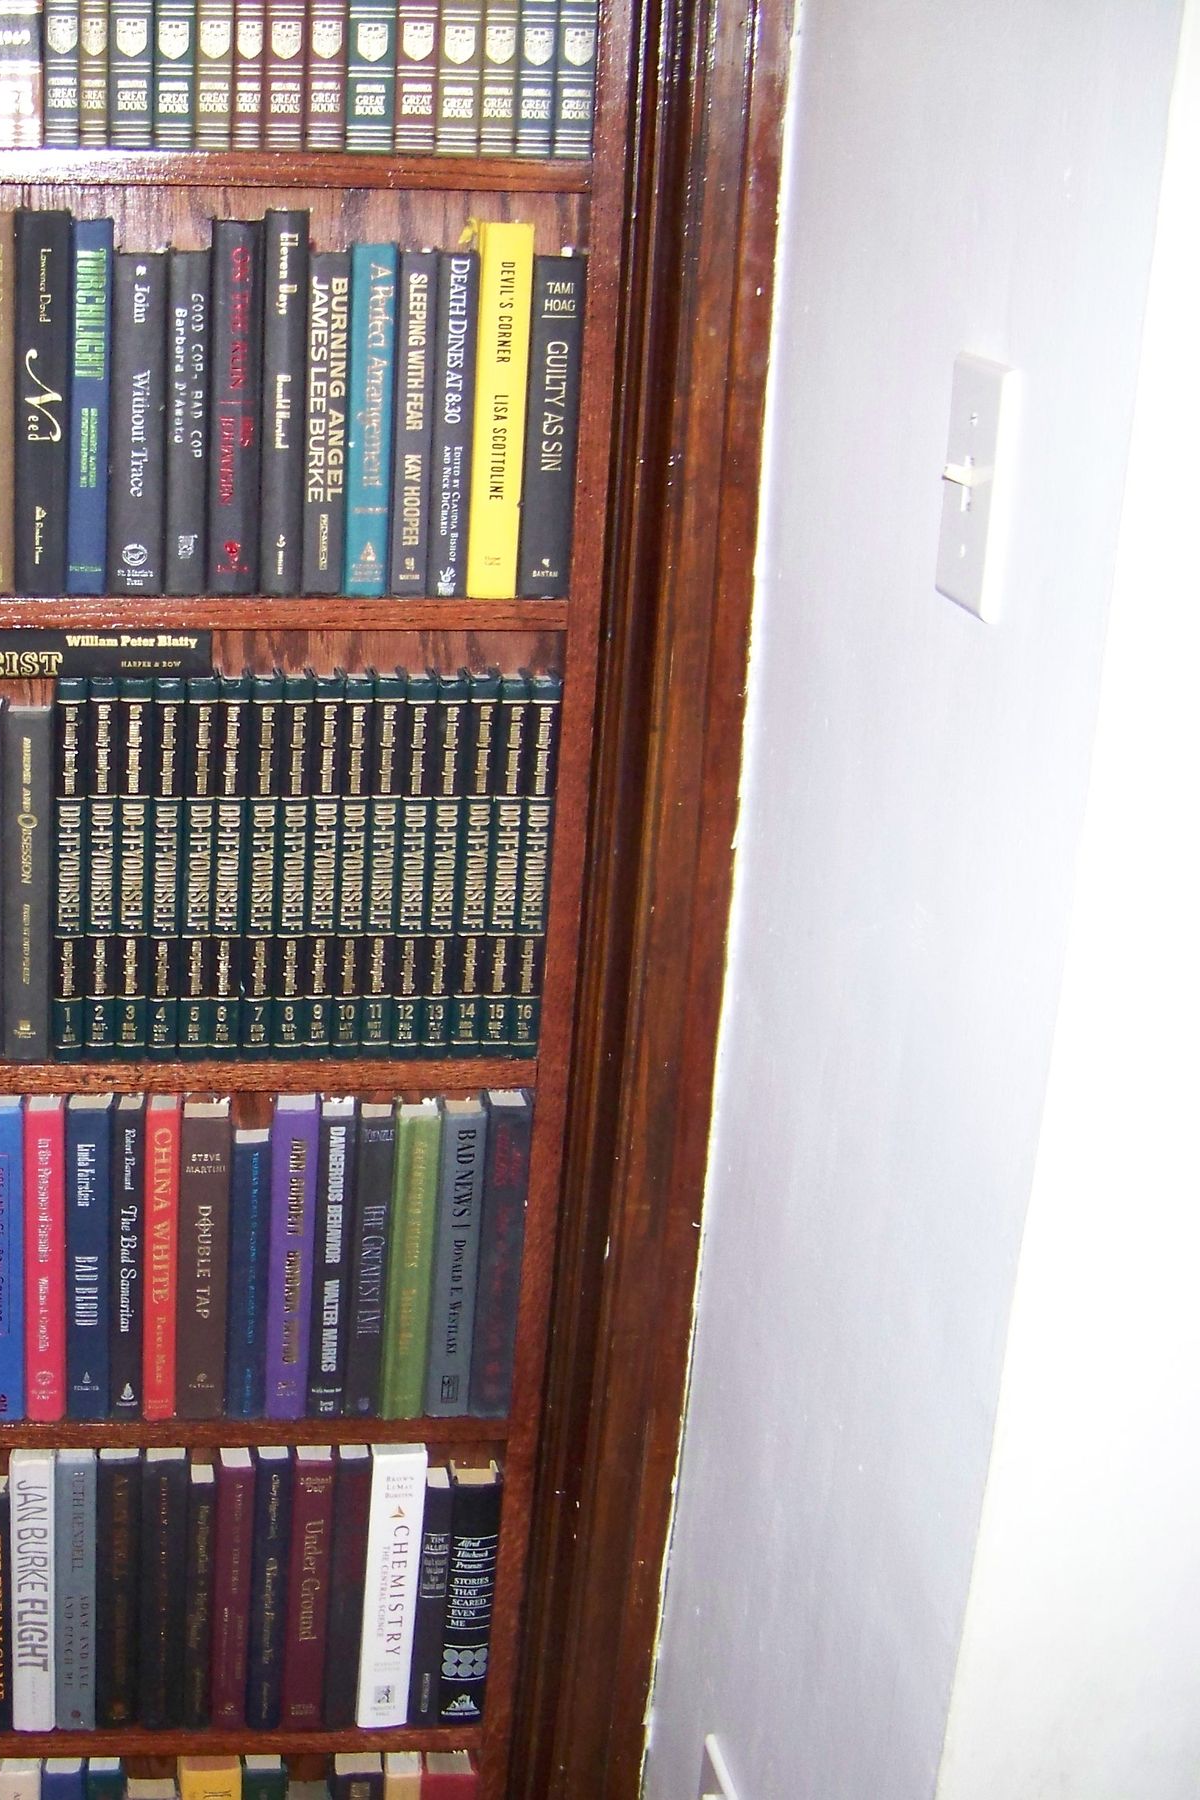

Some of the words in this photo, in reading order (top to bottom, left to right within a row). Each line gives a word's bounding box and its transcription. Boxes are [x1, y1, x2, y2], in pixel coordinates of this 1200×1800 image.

[159, 93, 189, 105] GREAT
[159, 104, 188, 115] BOOKS
[355, 95, 386, 107] GREAT
[355, 105, 386, 116] BOOKS
[561, 99, 590, 110] GREAT
[561, 109, 589, 120] BOOKS
[448, 259, 469, 315] DEATH
[499, 262, 515, 308] DEVIL'S
[547, 282, 575, 294] TAMI
[311, 276, 328, 361] JAMES
[408, 273, 426, 346] SLEEPING
[544, 299, 576, 311] HOAG
[331, 277, 348, 397] BURNING
[447, 320, 468, 368] DINES
[496, 315, 512, 363] CORNER
[407, 350, 425, 388] WITH
[447, 370, 463, 390] AT
[544, 341, 569, 406] GUILTY
[310, 367, 326, 413] LEE
[445, 393, 461, 423] 8:30
[494, 394, 509, 421] LISA
[406, 392, 423, 430] FEAR
[543, 412, 563, 435] AS
[308, 419, 325, 503] BURKE
[327, 409, 344, 501] ANGEL
[405, 454, 422, 481] KAY
[490, 428, 506, 500] SCOTTOLINE
[541, 441, 562, 471] SIN
[403, 486, 420, 545] HOOPER
[66, 636, 118, 647] William
[121, 636, 154, 647] Peter
[158, 636, 197, 648] Blatty
[541, 707, 553, 721] the
[536, 722, 551, 749] family
[534, 751, 549, 794] handyman
[327, 1127, 345, 1201] DANGEROUS
[456, 1129, 476, 1164] BAD
[452, 1170, 474, 1217] NEWS
[120, 1205, 137, 1231] The
[325, 1205, 342, 1263] BEHAVIOR
[120, 1235, 137, 1263] Bad
[195, 1206, 214, 1278] DOUBLE
[119, 1268, 135, 1332] Samaritan
[196, 1286, 211, 1319] TAP
[323, 1280, 340, 1325] WALTER
[321, 1328, 338, 1372] MARKS
[16, 1480, 48, 1522] JAN
[18, 1528, 48, 1593] BURKE
[301, 1520, 324, 1574] Under
[385, 1525, 410, 1656] CHEMISTRY
[453, 1588, 477, 1596] THAT
[454, 1577, 489, 1585] STORIES
[299, 1578, 320, 1641] Ground
[452, 1598, 486, 1606] SCARED
[452, 1609, 475, 1617] EVEN
[18, 1599, 48, 1672] FLIGHT
[451, 1619, 466, 1627] ME
